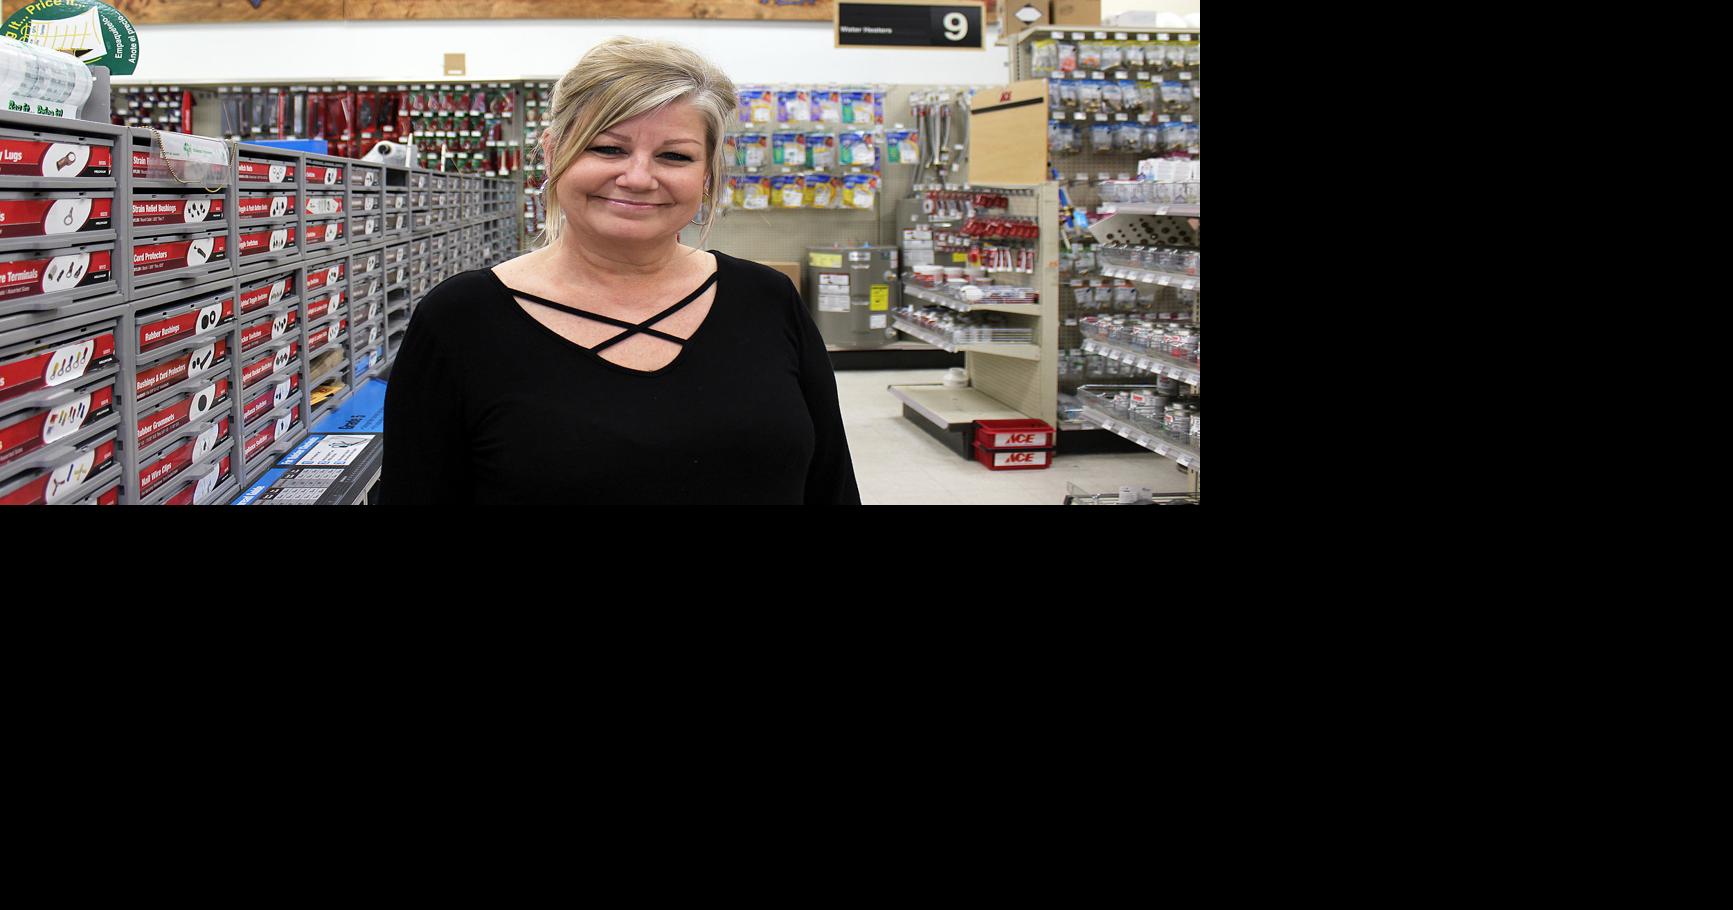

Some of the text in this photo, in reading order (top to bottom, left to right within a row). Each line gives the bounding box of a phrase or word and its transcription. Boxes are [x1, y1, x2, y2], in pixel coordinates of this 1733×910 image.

[26, 0, 61, 15] Price
[943, 12, 969, 41] 9
[128, 43, 137, 63] Anote
[4, 149, 23, 162] Lugs
[132, 204, 145, 213] Strain
[134, 251, 168, 263] Cord Protectors
[7, 268, 38, 283] Terminals
[145, 324, 180, 342] Rubber Bushings
[136, 377, 155, 390] Bushings
[160, 370, 168, 380] Cord
[168, 363, 186, 376] Protectors
[153, 413, 175, 430] Grommets
[1006, 433, 1037, 444] ACE
[1005, 452, 1035, 463] ACE
[141, 474, 151, 486] Nail
[151, 469, 161, 480] Wire
[161, 462, 172, 473] Clips
